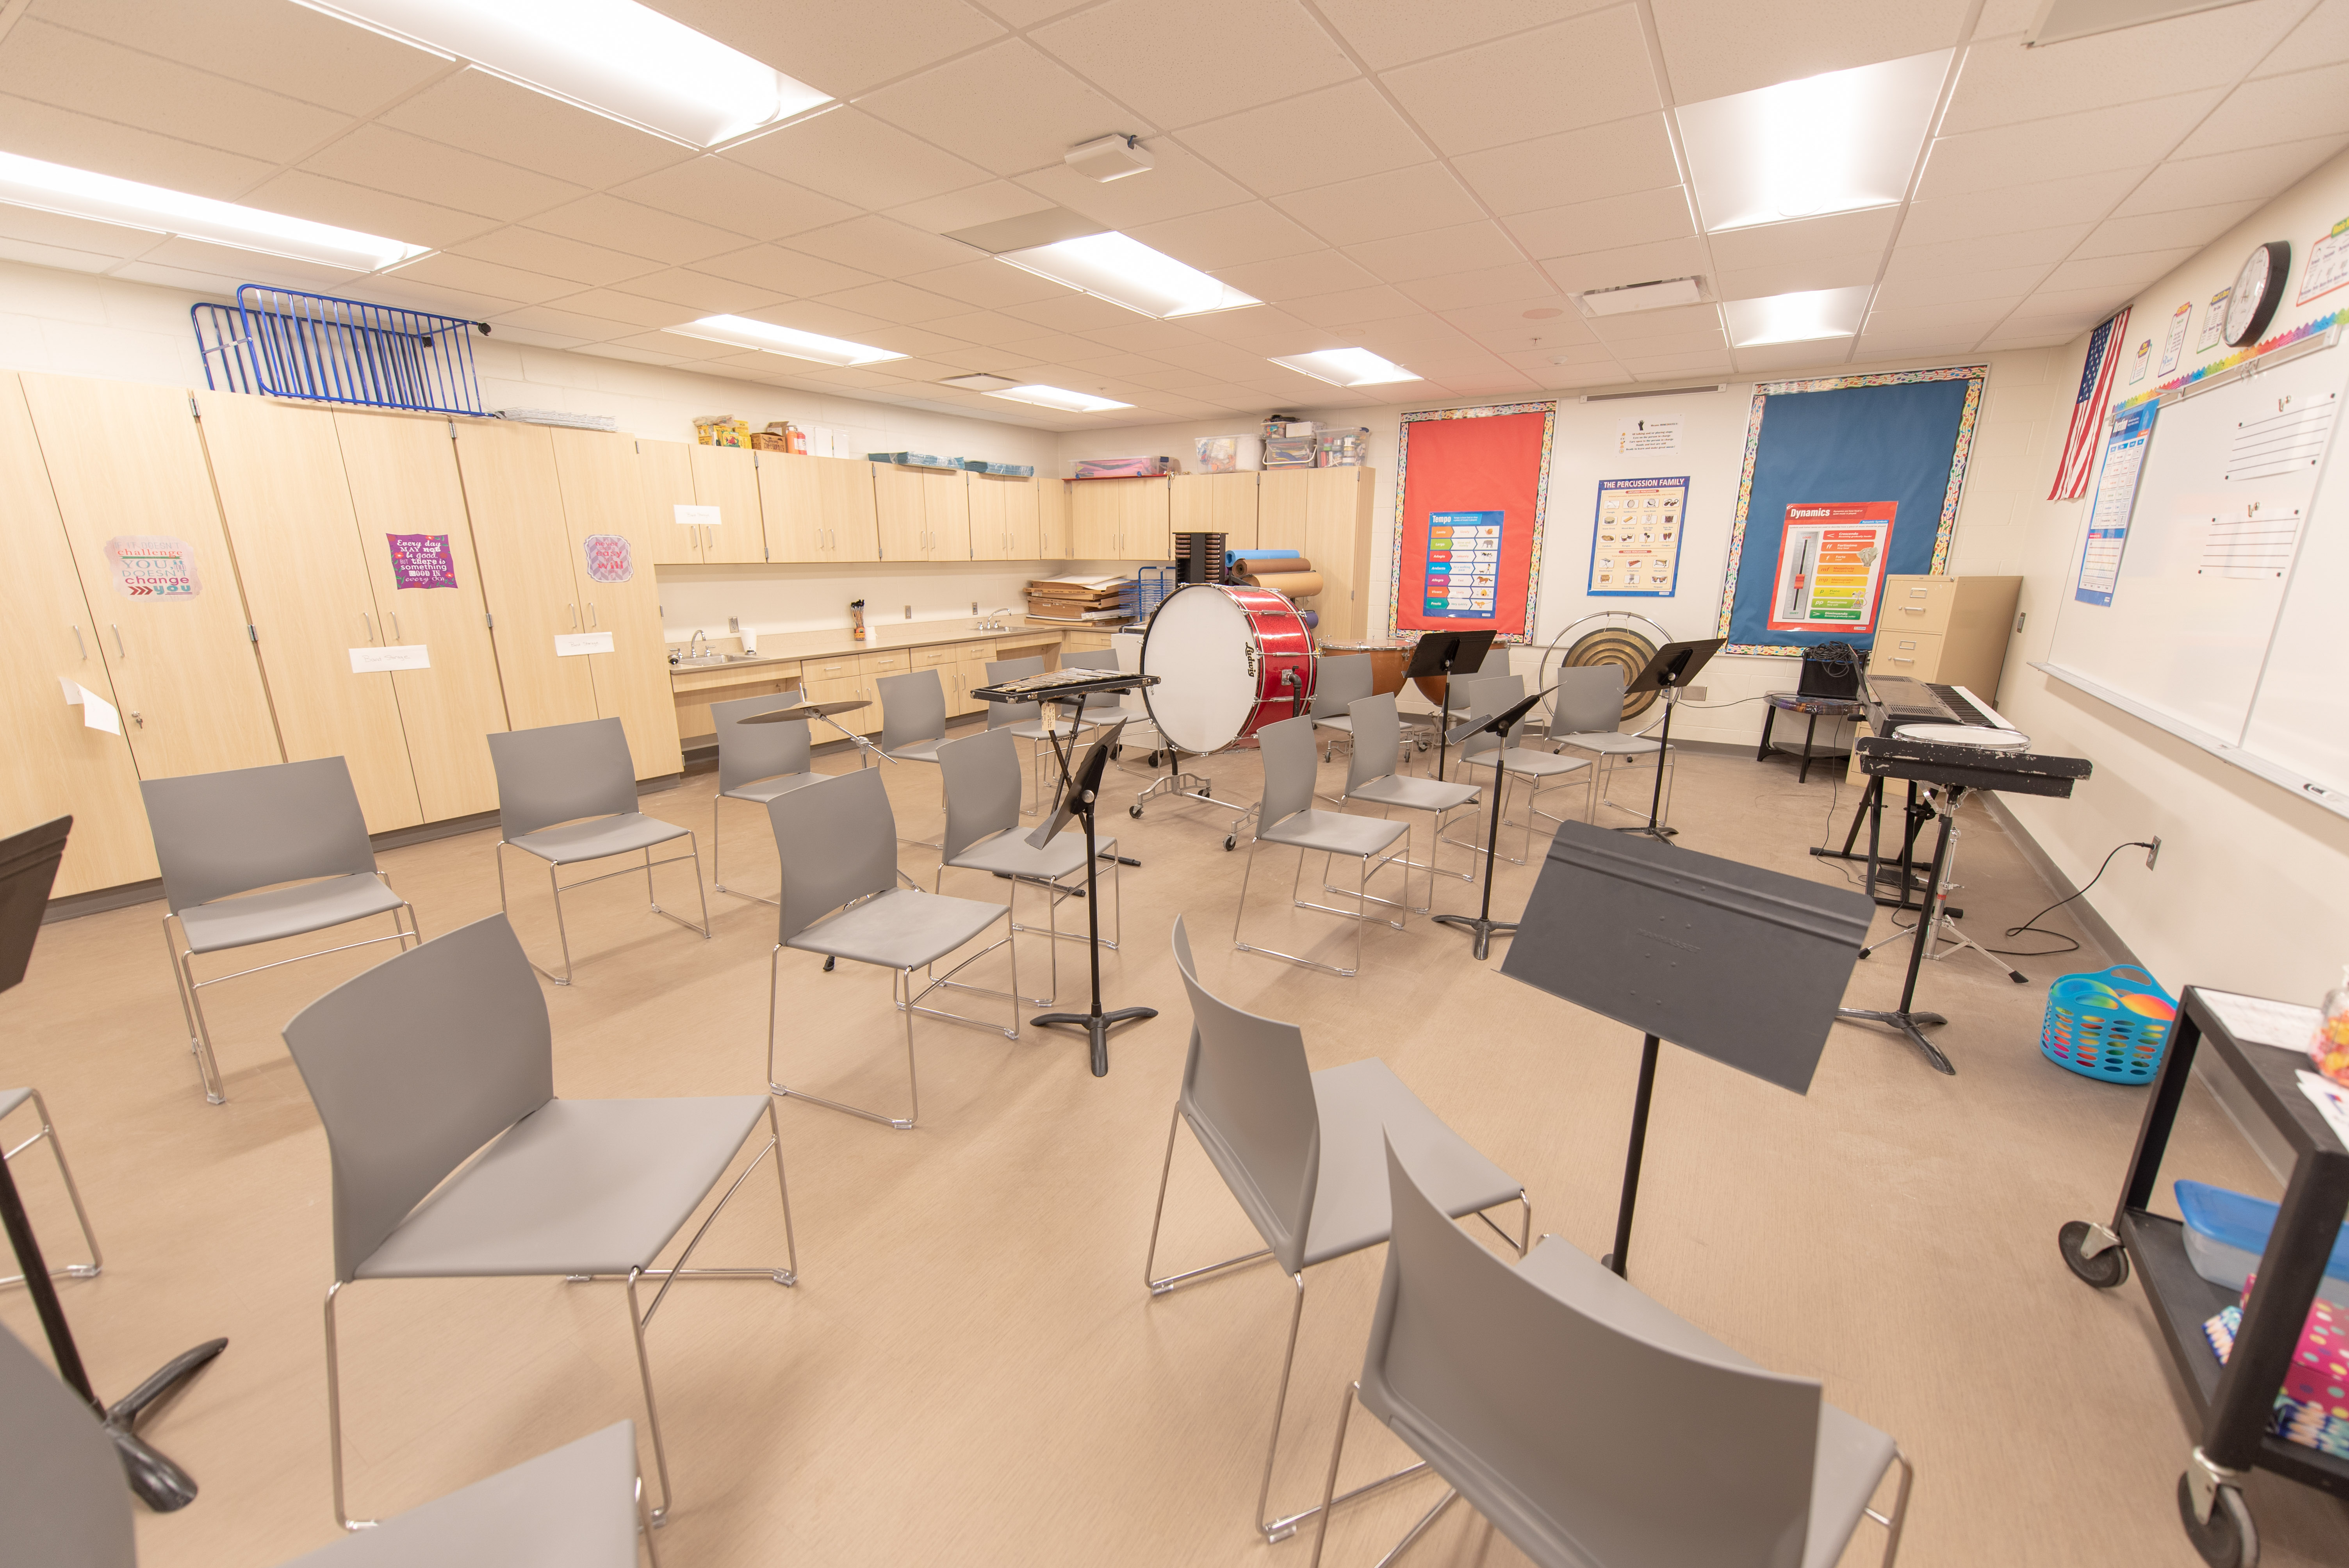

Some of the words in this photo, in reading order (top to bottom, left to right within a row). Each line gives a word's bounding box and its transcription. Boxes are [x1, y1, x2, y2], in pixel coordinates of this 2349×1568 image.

[1617, 479, 1658, 488] PERCUSSION
[1791, 508, 1830, 519] Dynamics
[1433, 515, 1451, 524] Tempo
[118, 549, 183, 558] challenge
[125, 576, 189, 586] change
[153, 585, 191, 595] you
[1246, 641, 1255, 677] Ludwig
[1637, 928, 1701, 953] MANHASSET
